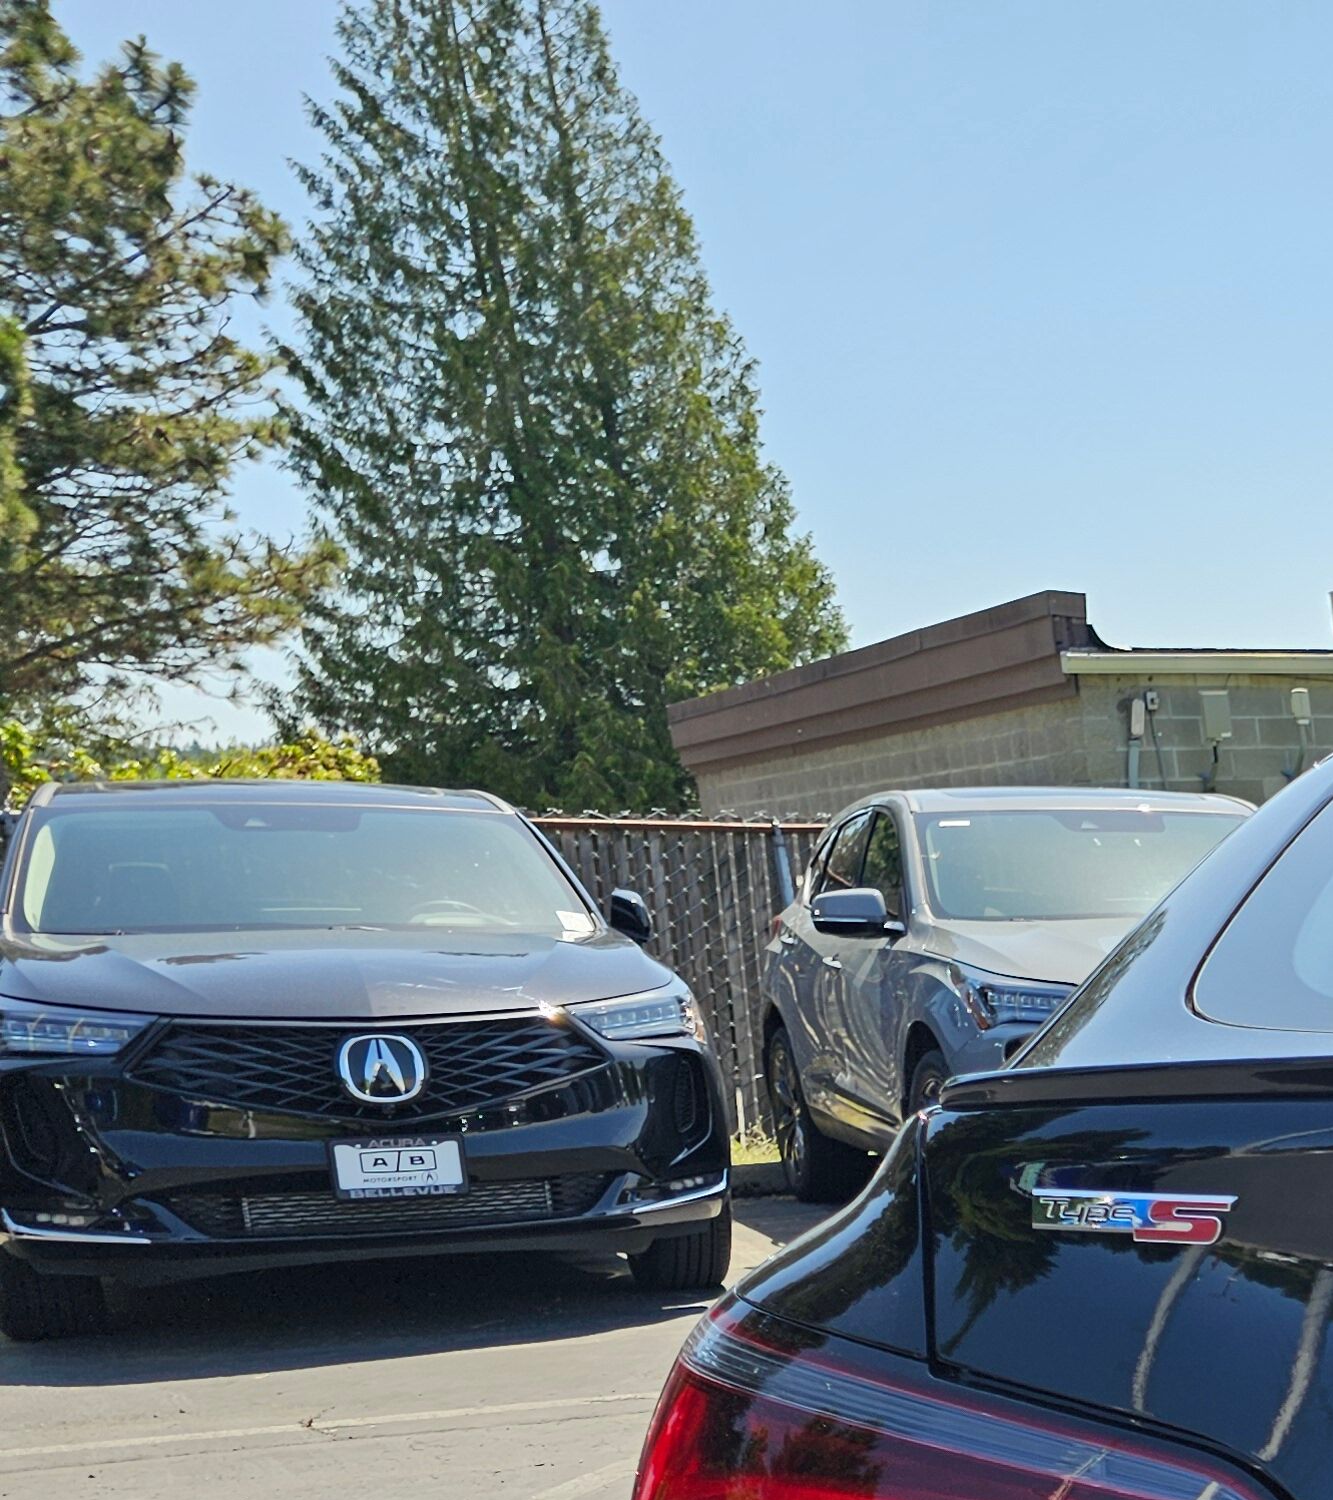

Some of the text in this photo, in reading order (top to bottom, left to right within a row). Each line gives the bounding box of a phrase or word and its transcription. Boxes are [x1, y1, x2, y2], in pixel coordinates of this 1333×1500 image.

[368, 1138, 426, 1148] ACURA
[373, 1156, 425, 1167] A B
[349, 1185, 457, 1199] BELLEVUE
[1133, 1199, 1232, 1245] S
